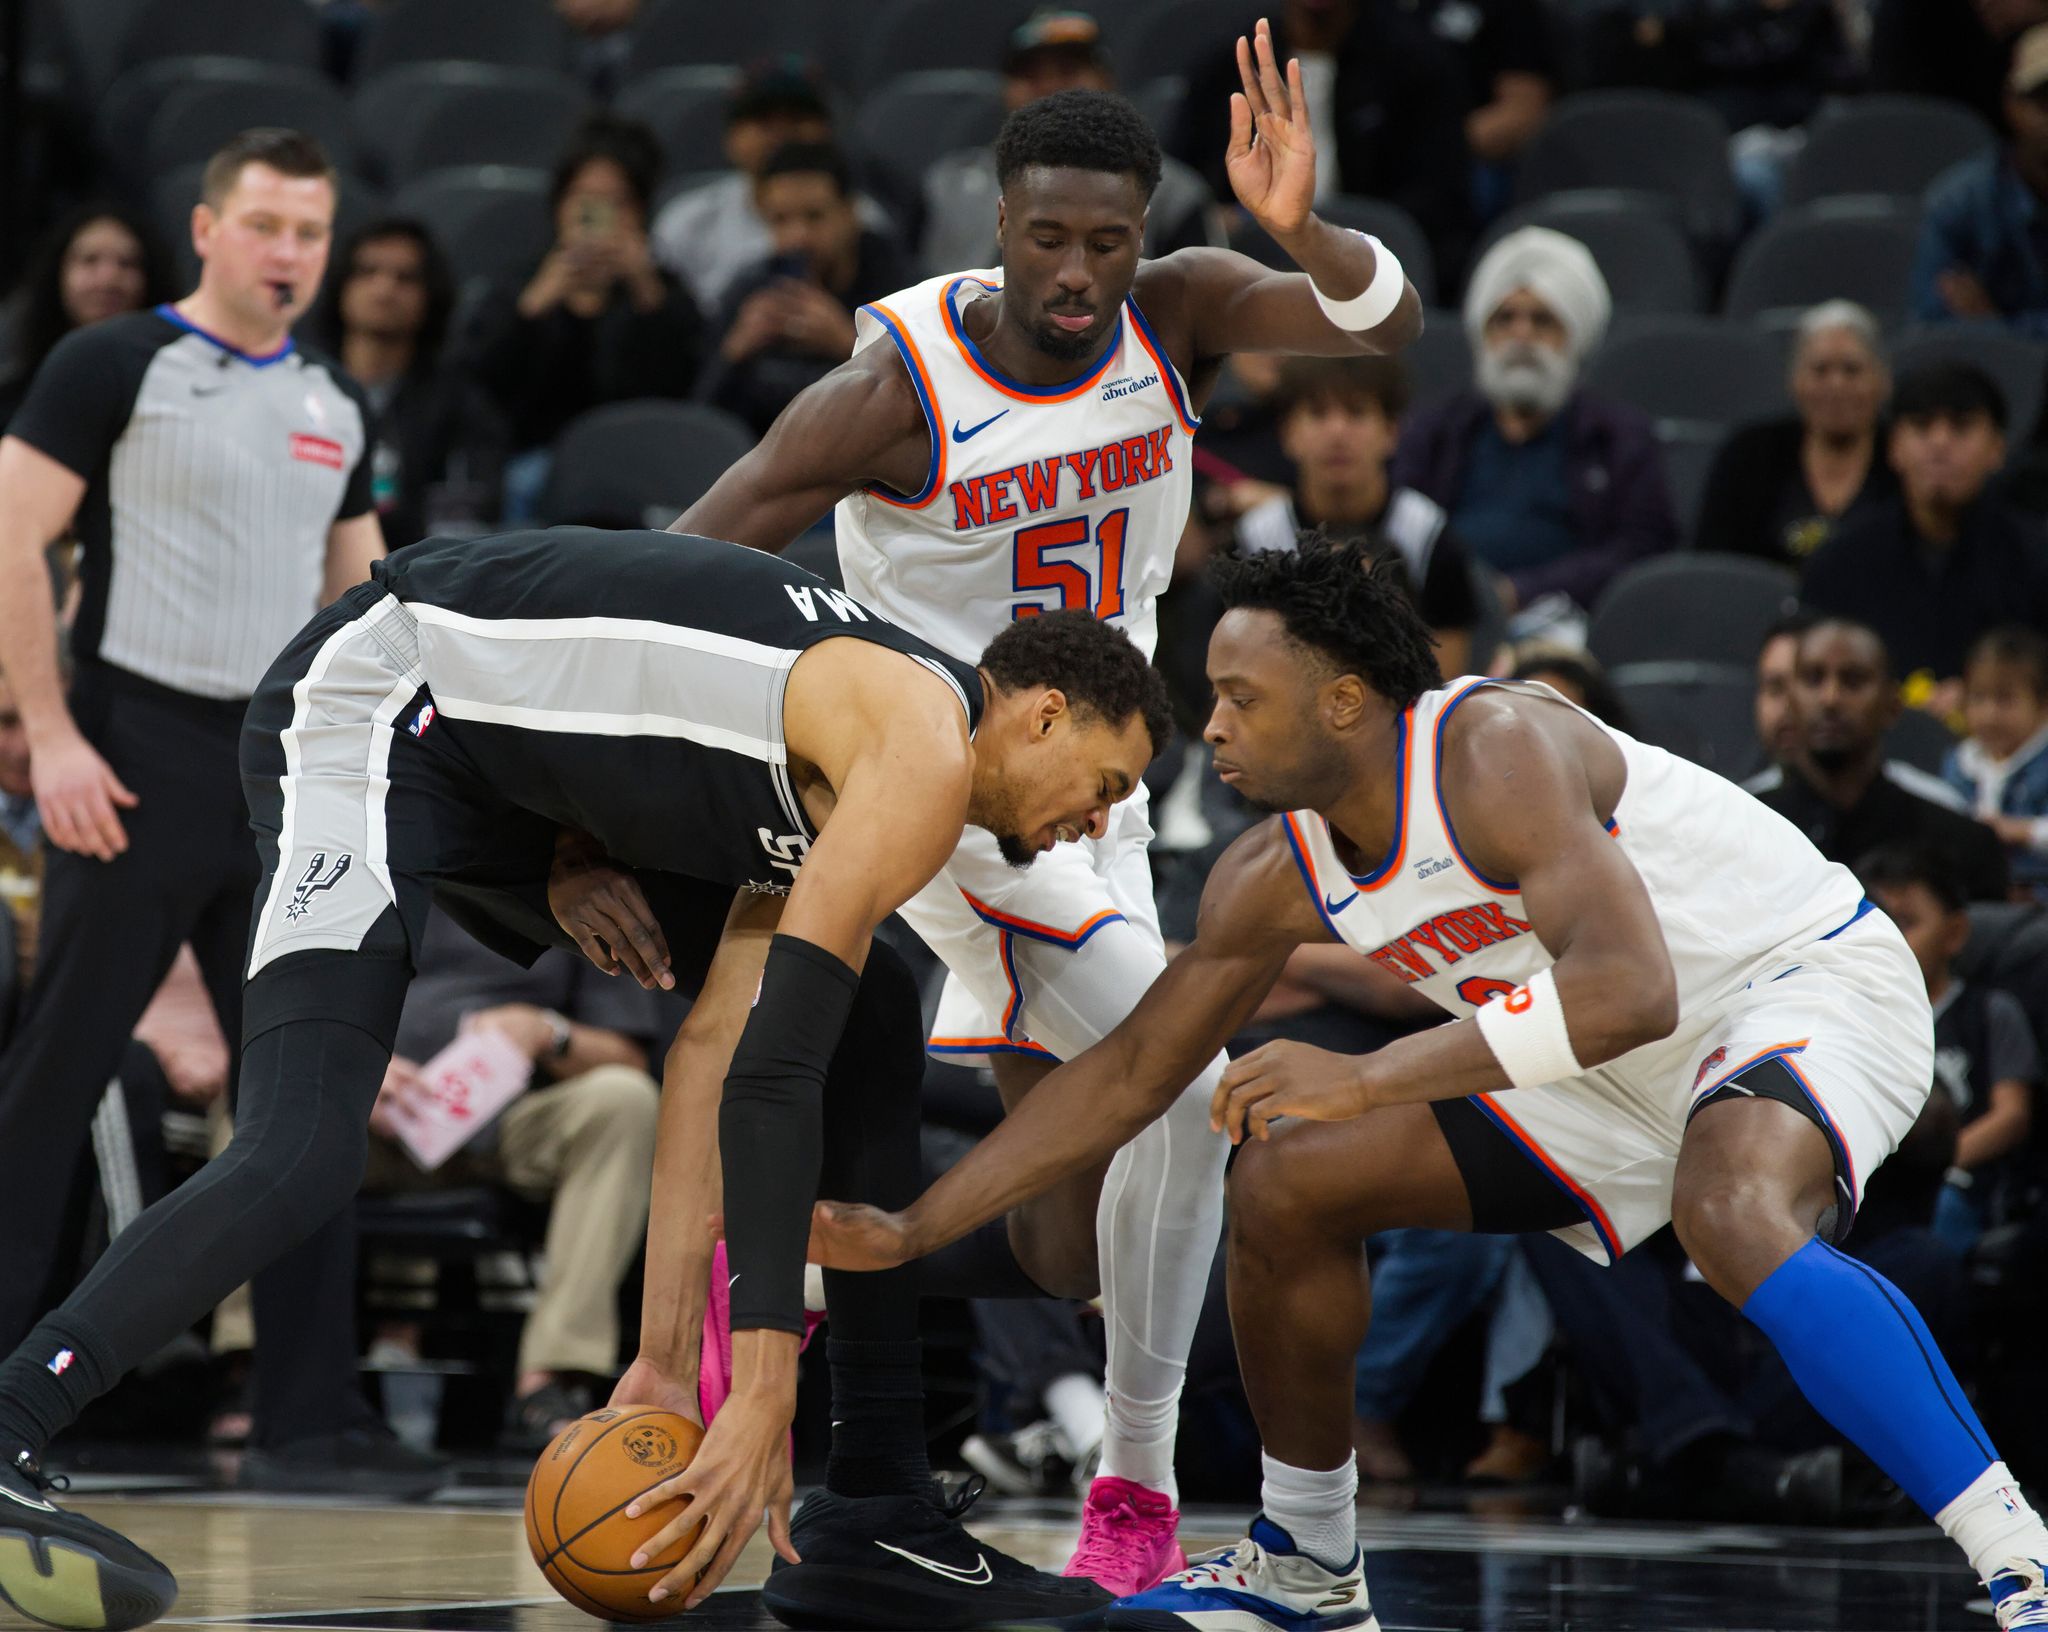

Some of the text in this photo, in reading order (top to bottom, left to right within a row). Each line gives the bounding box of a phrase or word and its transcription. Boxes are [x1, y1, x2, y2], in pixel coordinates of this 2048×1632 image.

[1102, 386, 1128, 401] abu
[1012, 507, 1130, 622] 51
[1406, 901, 1534, 966] YORK
